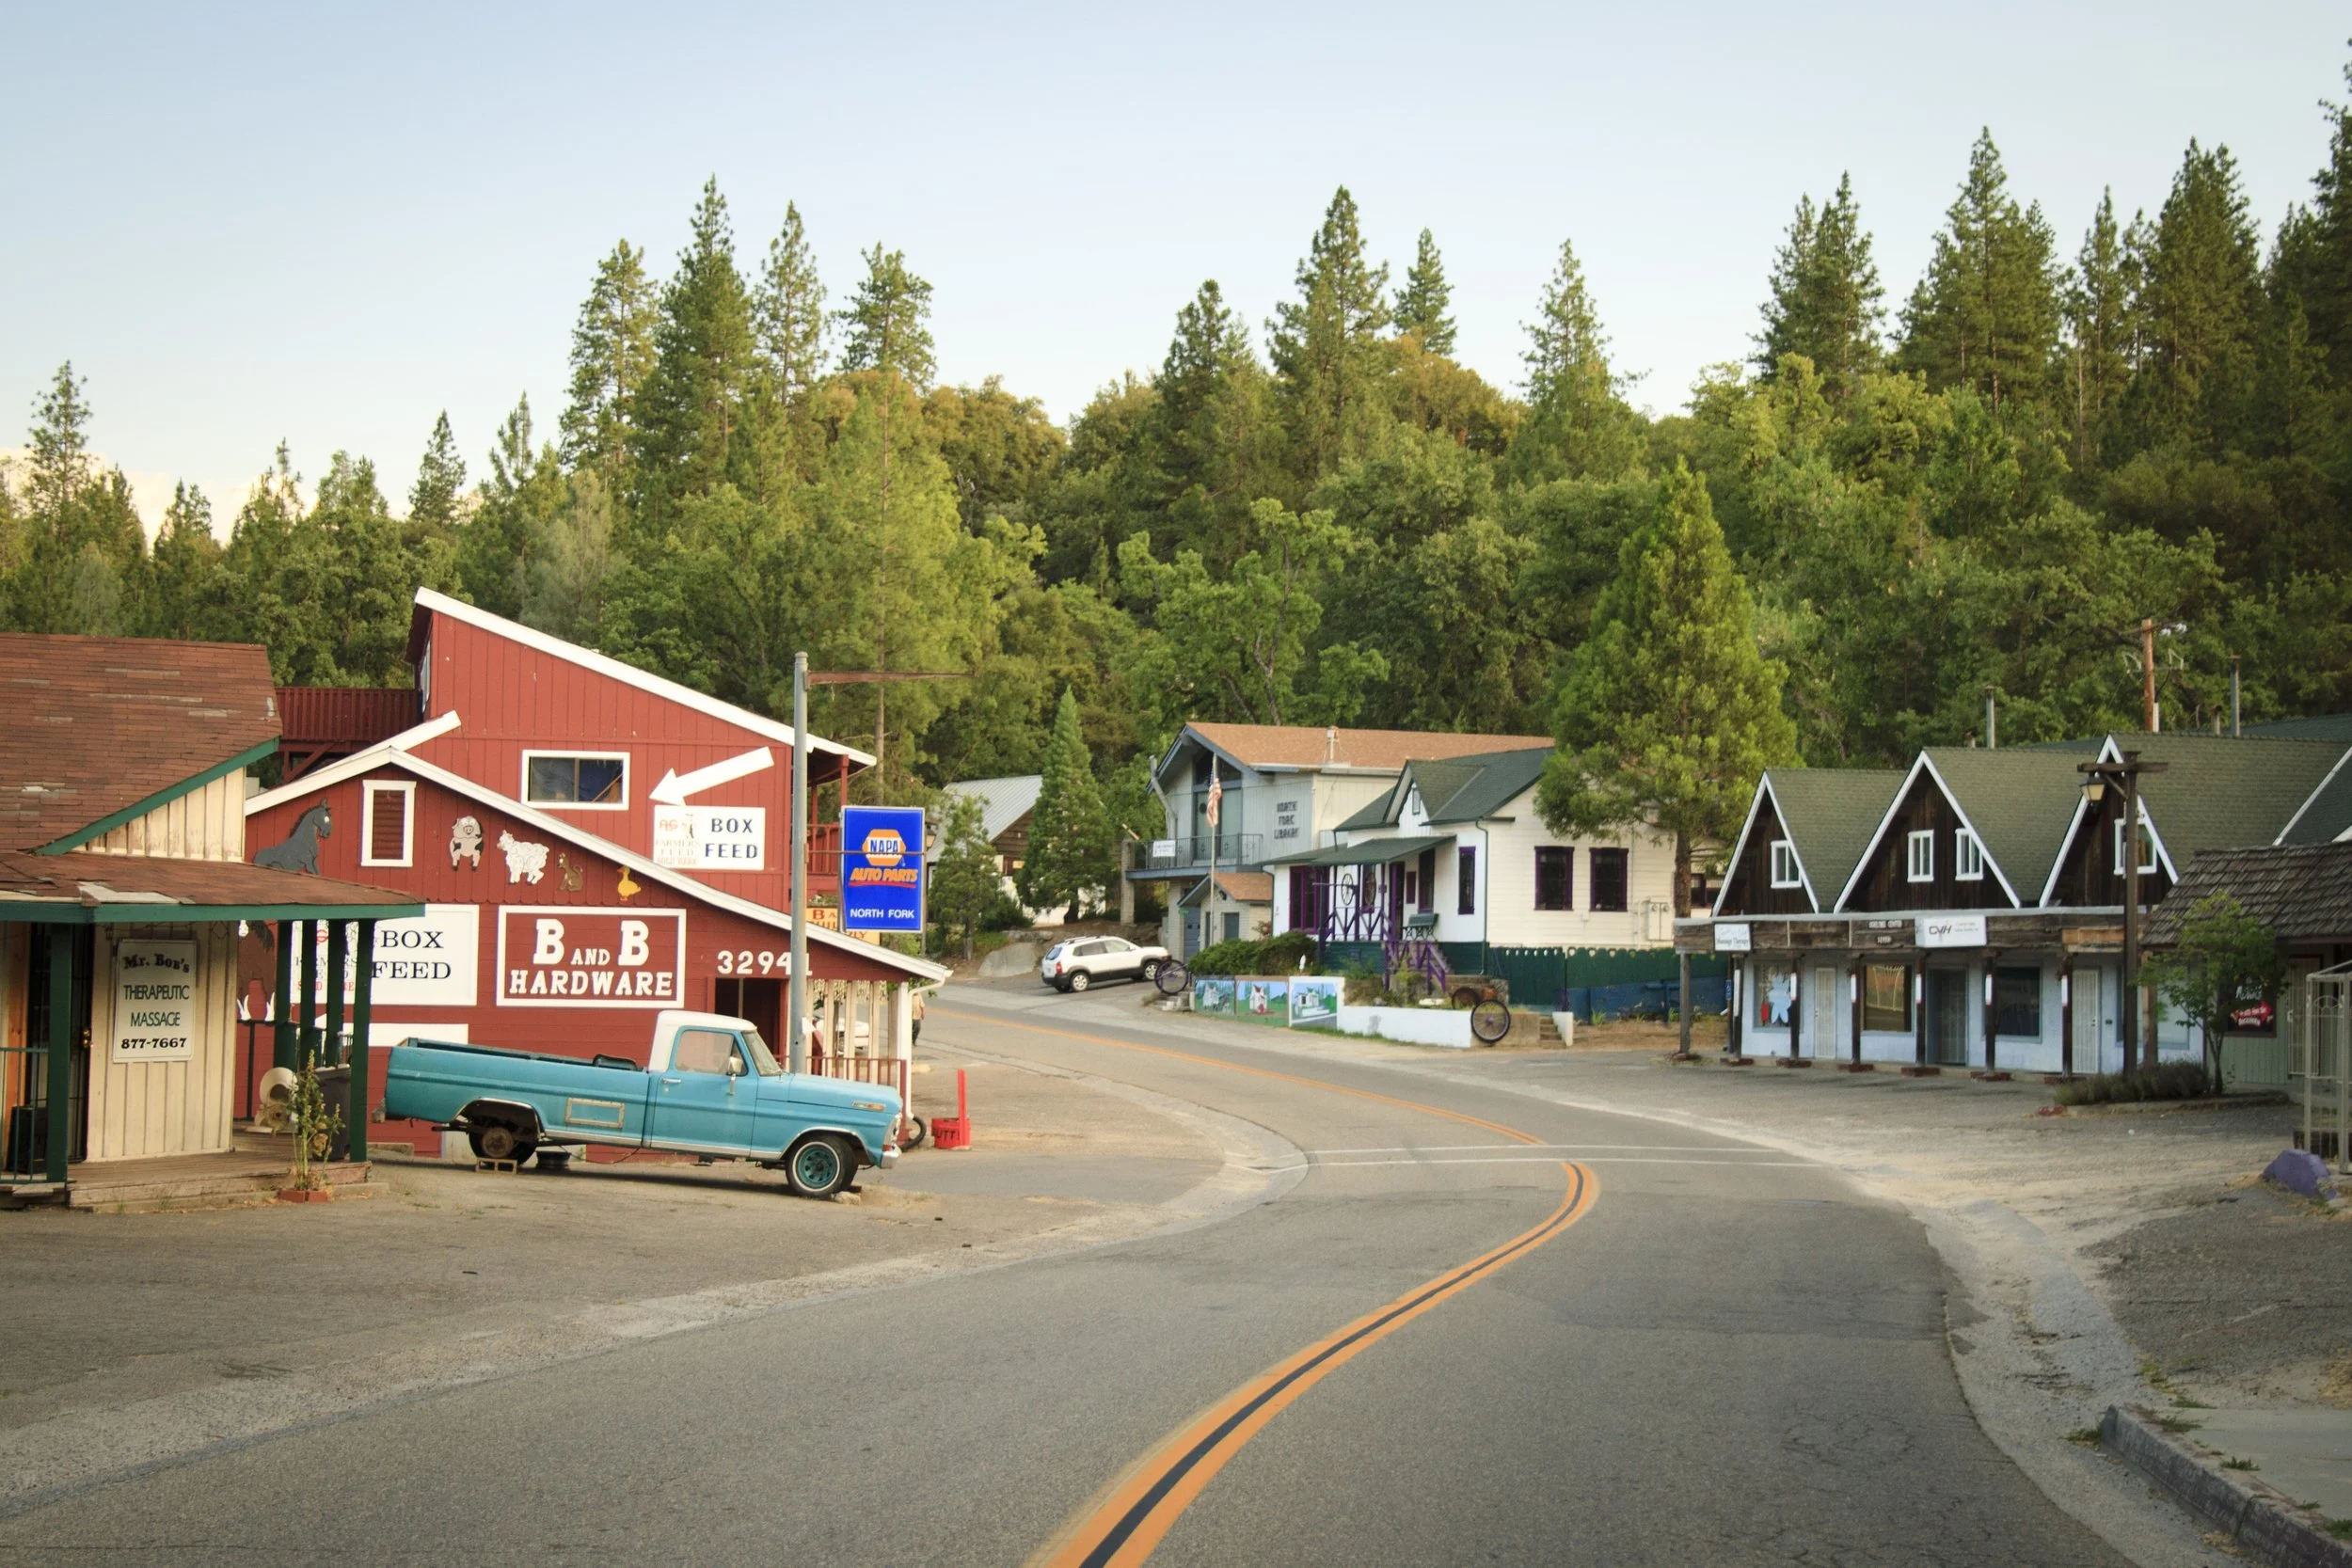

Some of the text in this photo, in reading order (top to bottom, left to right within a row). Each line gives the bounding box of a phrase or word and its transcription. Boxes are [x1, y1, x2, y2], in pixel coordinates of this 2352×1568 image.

[711, 817, 753, 833] BOX
[705, 843, 758, 859] FEED
[870, 839, 898, 855] NAPA
[850, 867, 918, 882] AUTO PARTS
[850, 908, 884, 919] NORTH
[887, 909, 914, 919] FORK
[380, 930, 444, 949] BOX
[532, 918, 649, 966] B AND B
[123, 954, 150, 970] Mr.
[372, 961, 452, 979] FEED
[509, 969, 674, 996] HARDWARE
[123, 984, 190, 1000] THERAPEUTIC
[130, 1011, 181, 1027] MASSAGE
[120, 1037, 187, 1049] 877-7667
